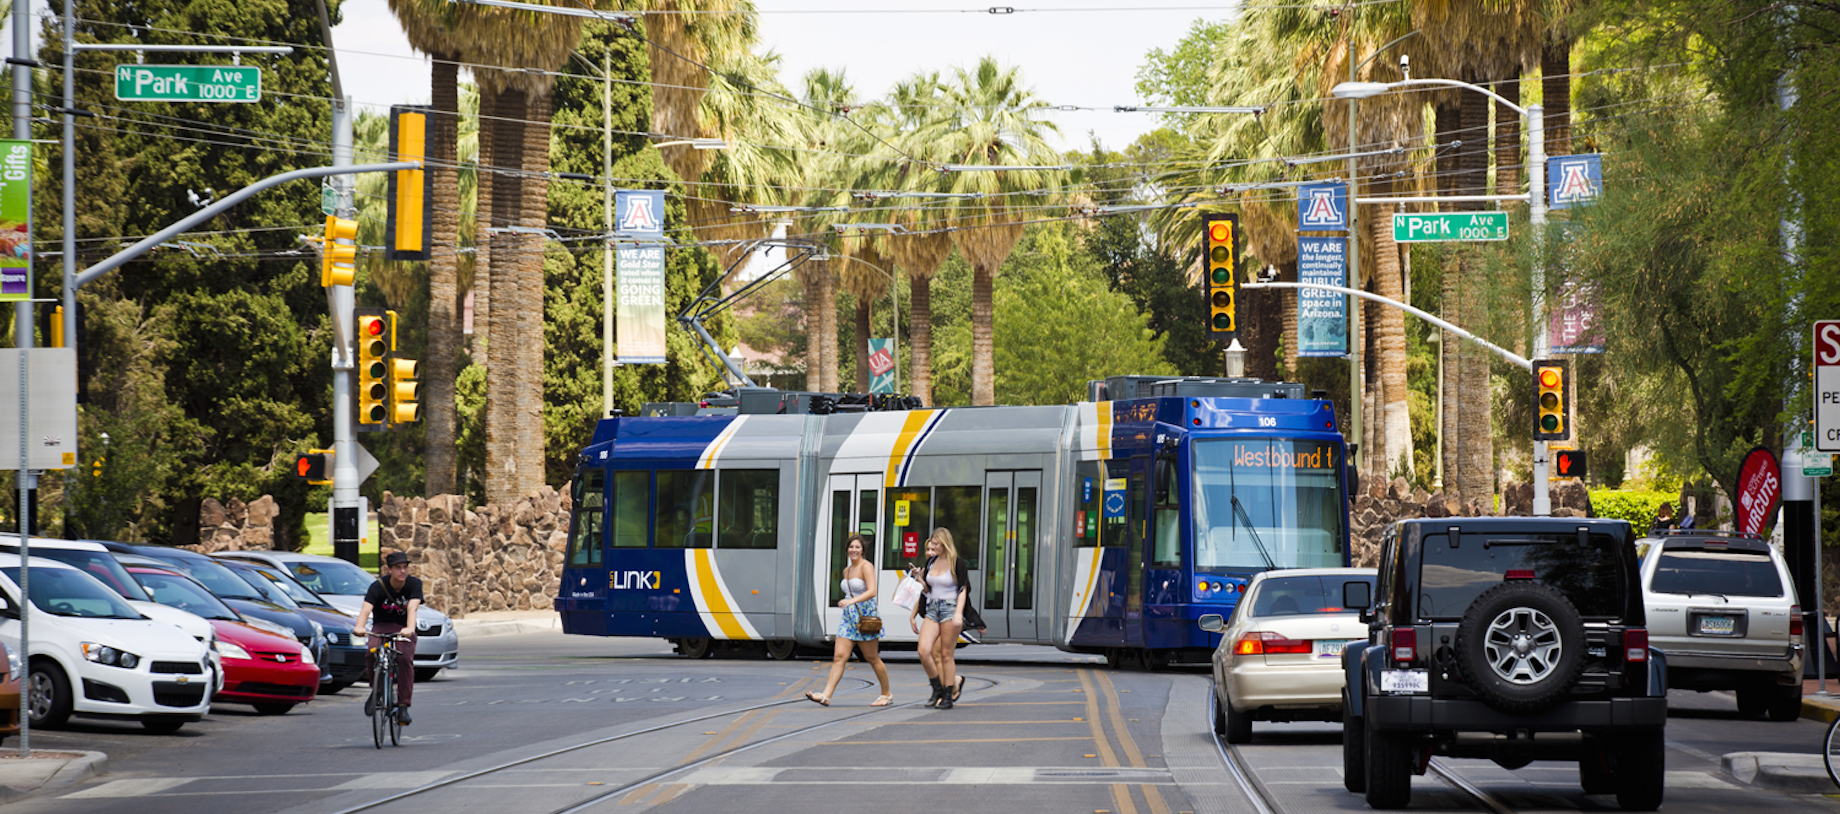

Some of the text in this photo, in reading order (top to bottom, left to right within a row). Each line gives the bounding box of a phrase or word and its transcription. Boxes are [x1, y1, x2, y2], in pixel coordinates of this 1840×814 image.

[120, 68, 243, 95] N Park Ave
[199, 84, 256, 99] 1000 E
[4, 145, 28, 181] Gifts
[1396, 214, 1494, 238] N Park Ave
[1459, 226, 1505, 239] 1000 E
[1302, 243, 1342, 252] WE ARE
[620, 249, 660, 259] WE ARE
[1302, 253, 1344, 263] the longest,
[620, 260, 660, 269] Gold Star
[1302, 262, 1342, 270] continually
[620, 269, 660, 277] rated when
[1302, 277, 1342, 287] PUBLIC
[620, 284, 660, 295] GOING
[1301, 287, 1342, 298] GREEN
[621, 295, 663, 306] GREEN.
[1302, 298, 1342, 309] space in
[1302, 308, 1342, 318] Arizona.
[868, 352, 891, 369] UA
[1259, 416, 1277, 427] 106
[1234, 445, 1321, 469] Westbound
[1744, 471, 1778, 539] AIRCUTS
